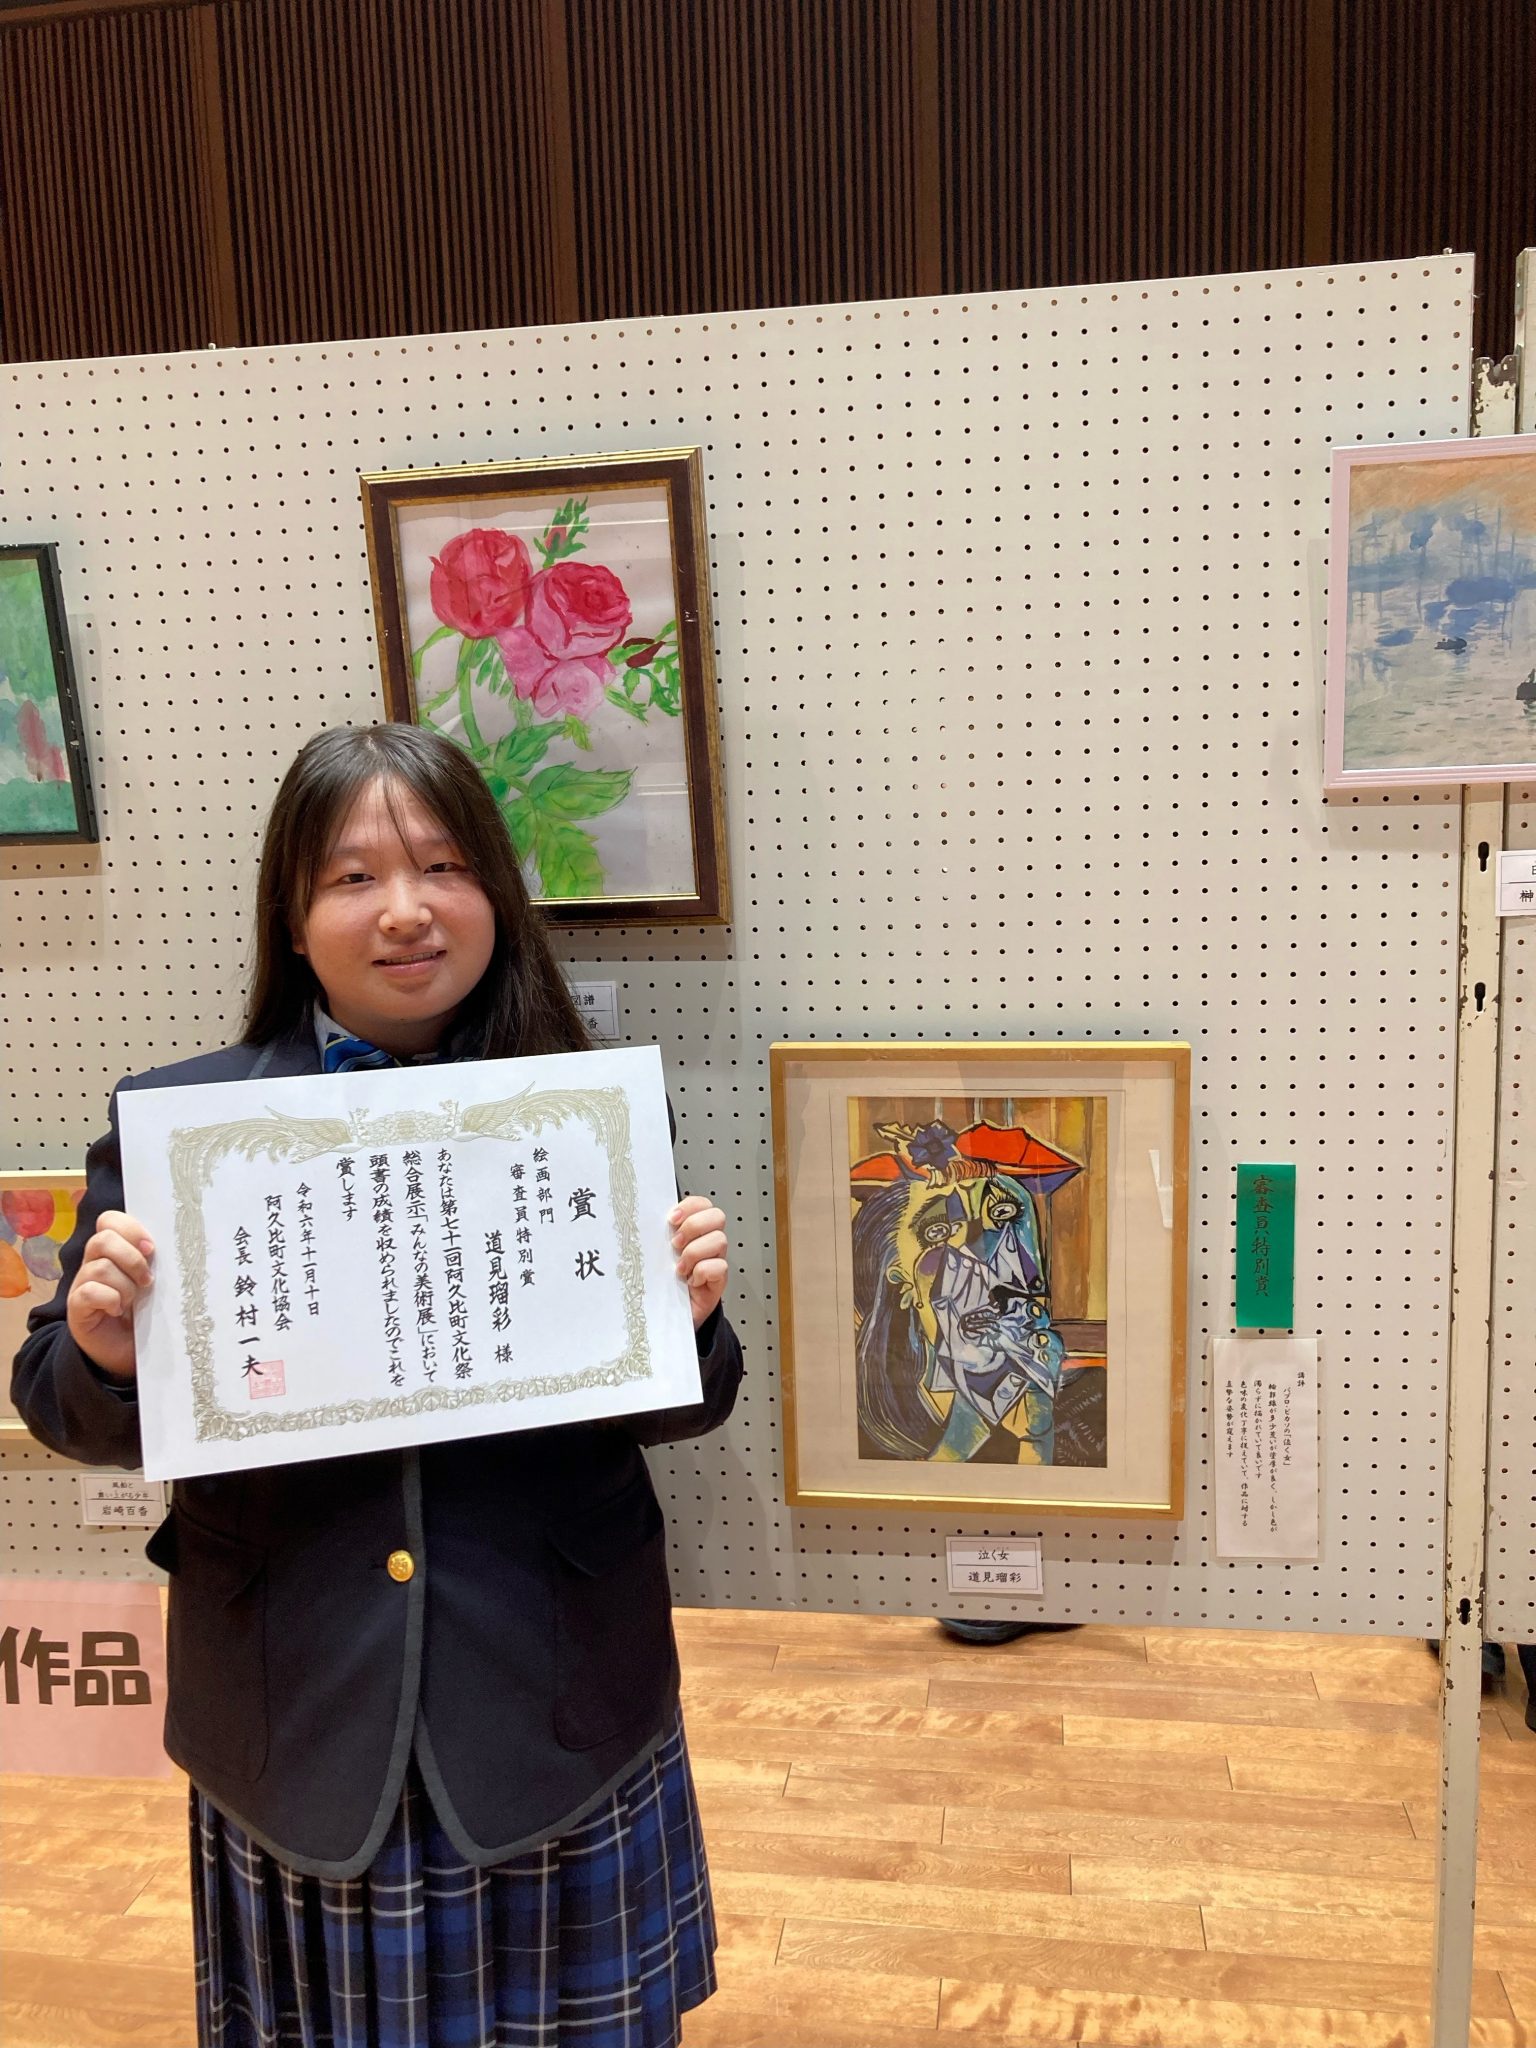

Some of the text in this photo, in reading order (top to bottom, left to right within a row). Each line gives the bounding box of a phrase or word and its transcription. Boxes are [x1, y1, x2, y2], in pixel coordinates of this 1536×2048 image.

[336, 1156, 358, 1222] 賞します
[510, 1163, 536, 1288] 審査員特別賞
[532, 1146, 555, 1224] 絵画部門
[568, 1187, 605, 1281] 賞状
[1251, 1174, 1275, 1297] 審査員特別賞
[264, 1194, 293, 1332] 阿久比町文化協会
[296, 1181, 321, 1316] 令和六年十一月十日
[369, 1153, 407, 1387] 頭書の成績を収められましたのでこれを
[402, 1149, 439, 1383] 総合展示「みんなの美術展」において
[437, 1147, 474, 1380] あなたは第七十一回阿久比町文化祭
[968, 1571, 1022, 1583] 道見瑠彩
[978, 1549, 1010, 1561] 泣く女
